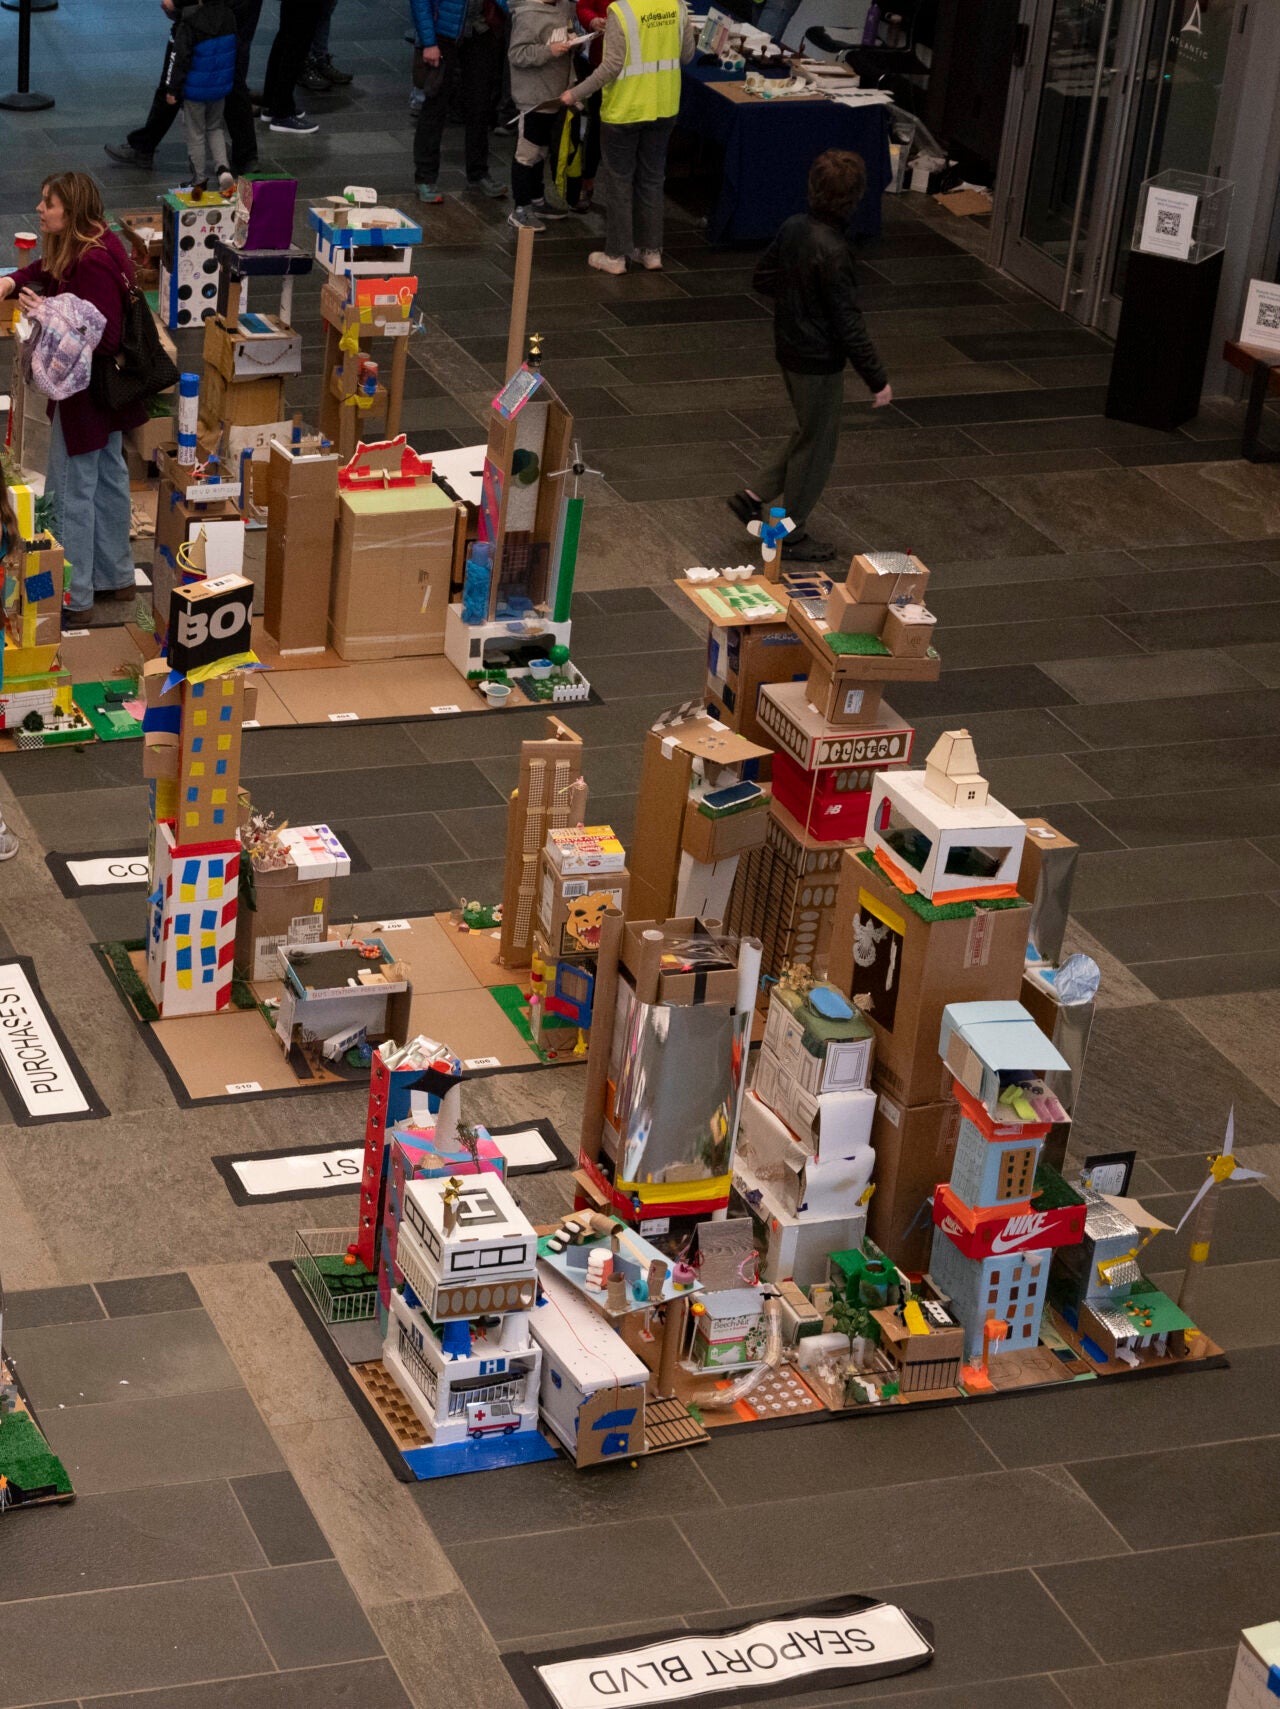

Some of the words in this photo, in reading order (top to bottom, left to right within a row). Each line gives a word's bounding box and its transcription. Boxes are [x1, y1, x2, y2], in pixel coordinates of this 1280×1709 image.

[1170, 35, 1209, 60] ATLANTIC
[178, 601, 252, 648] BO
[835, 744, 888, 757] HUNTER
[323, 1158, 360, 1179] ST
[1002, 1212, 1048, 1237] NIKE
[702, 1628, 876, 1677] SEAPORT
[589, 1655, 693, 1696] BLVD
